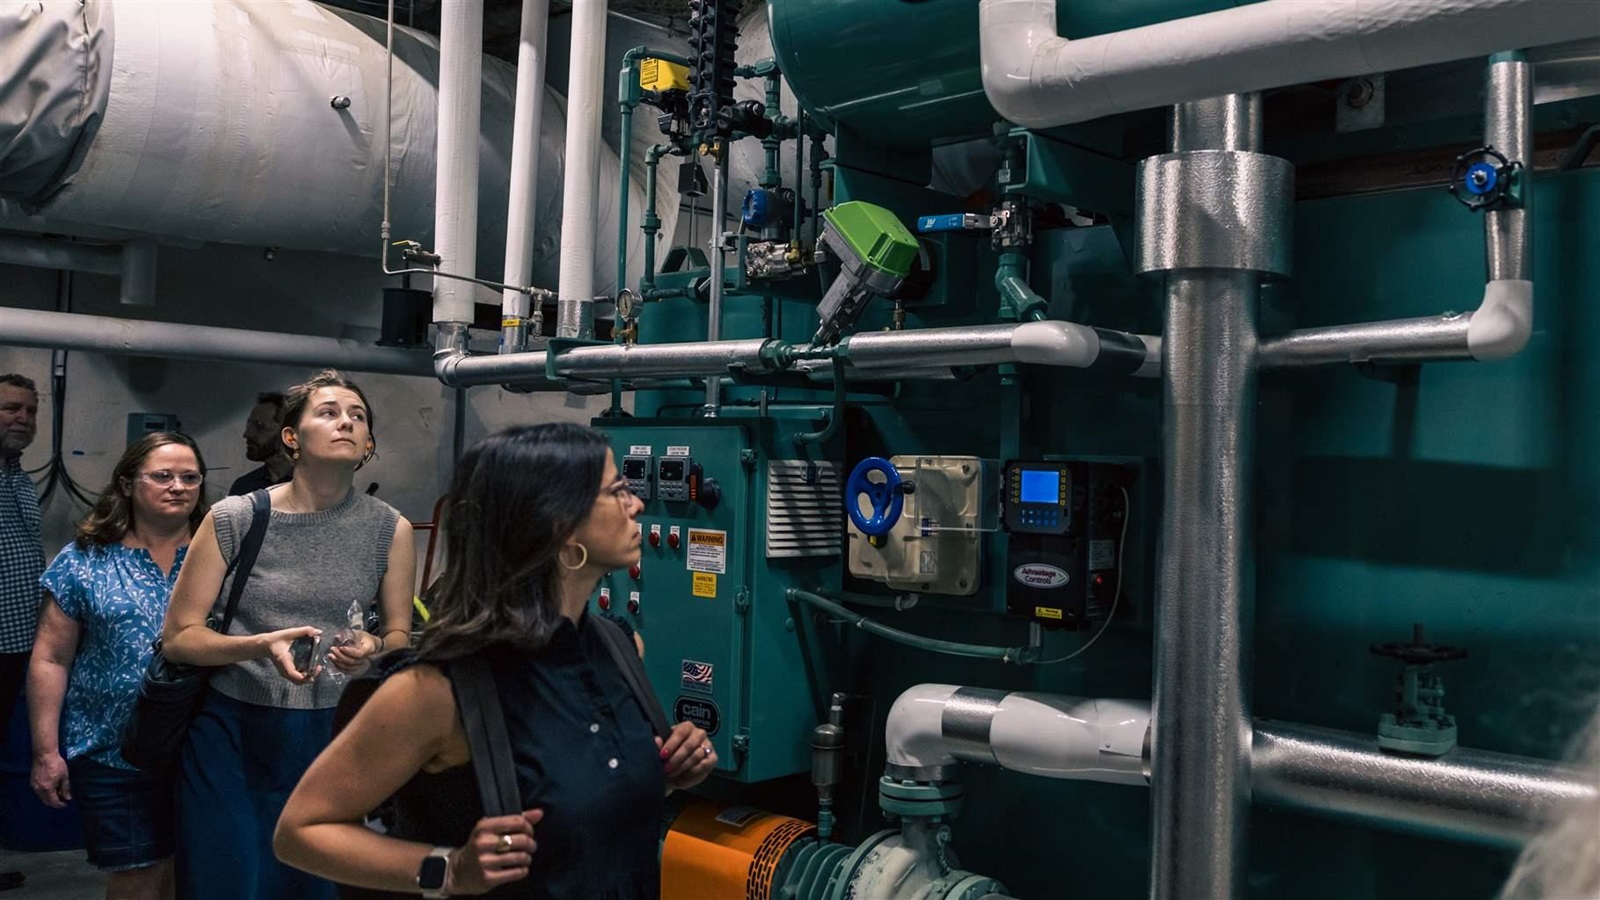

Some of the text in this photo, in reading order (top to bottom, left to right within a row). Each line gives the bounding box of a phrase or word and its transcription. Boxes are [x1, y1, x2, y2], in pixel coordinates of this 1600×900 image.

[697, 534, 723, 544] WARNING
[1022, 568, 1056, 578] Advantage
[1025, 575, 1051, 584] Controls
[683, 703, 711, 720] cain
